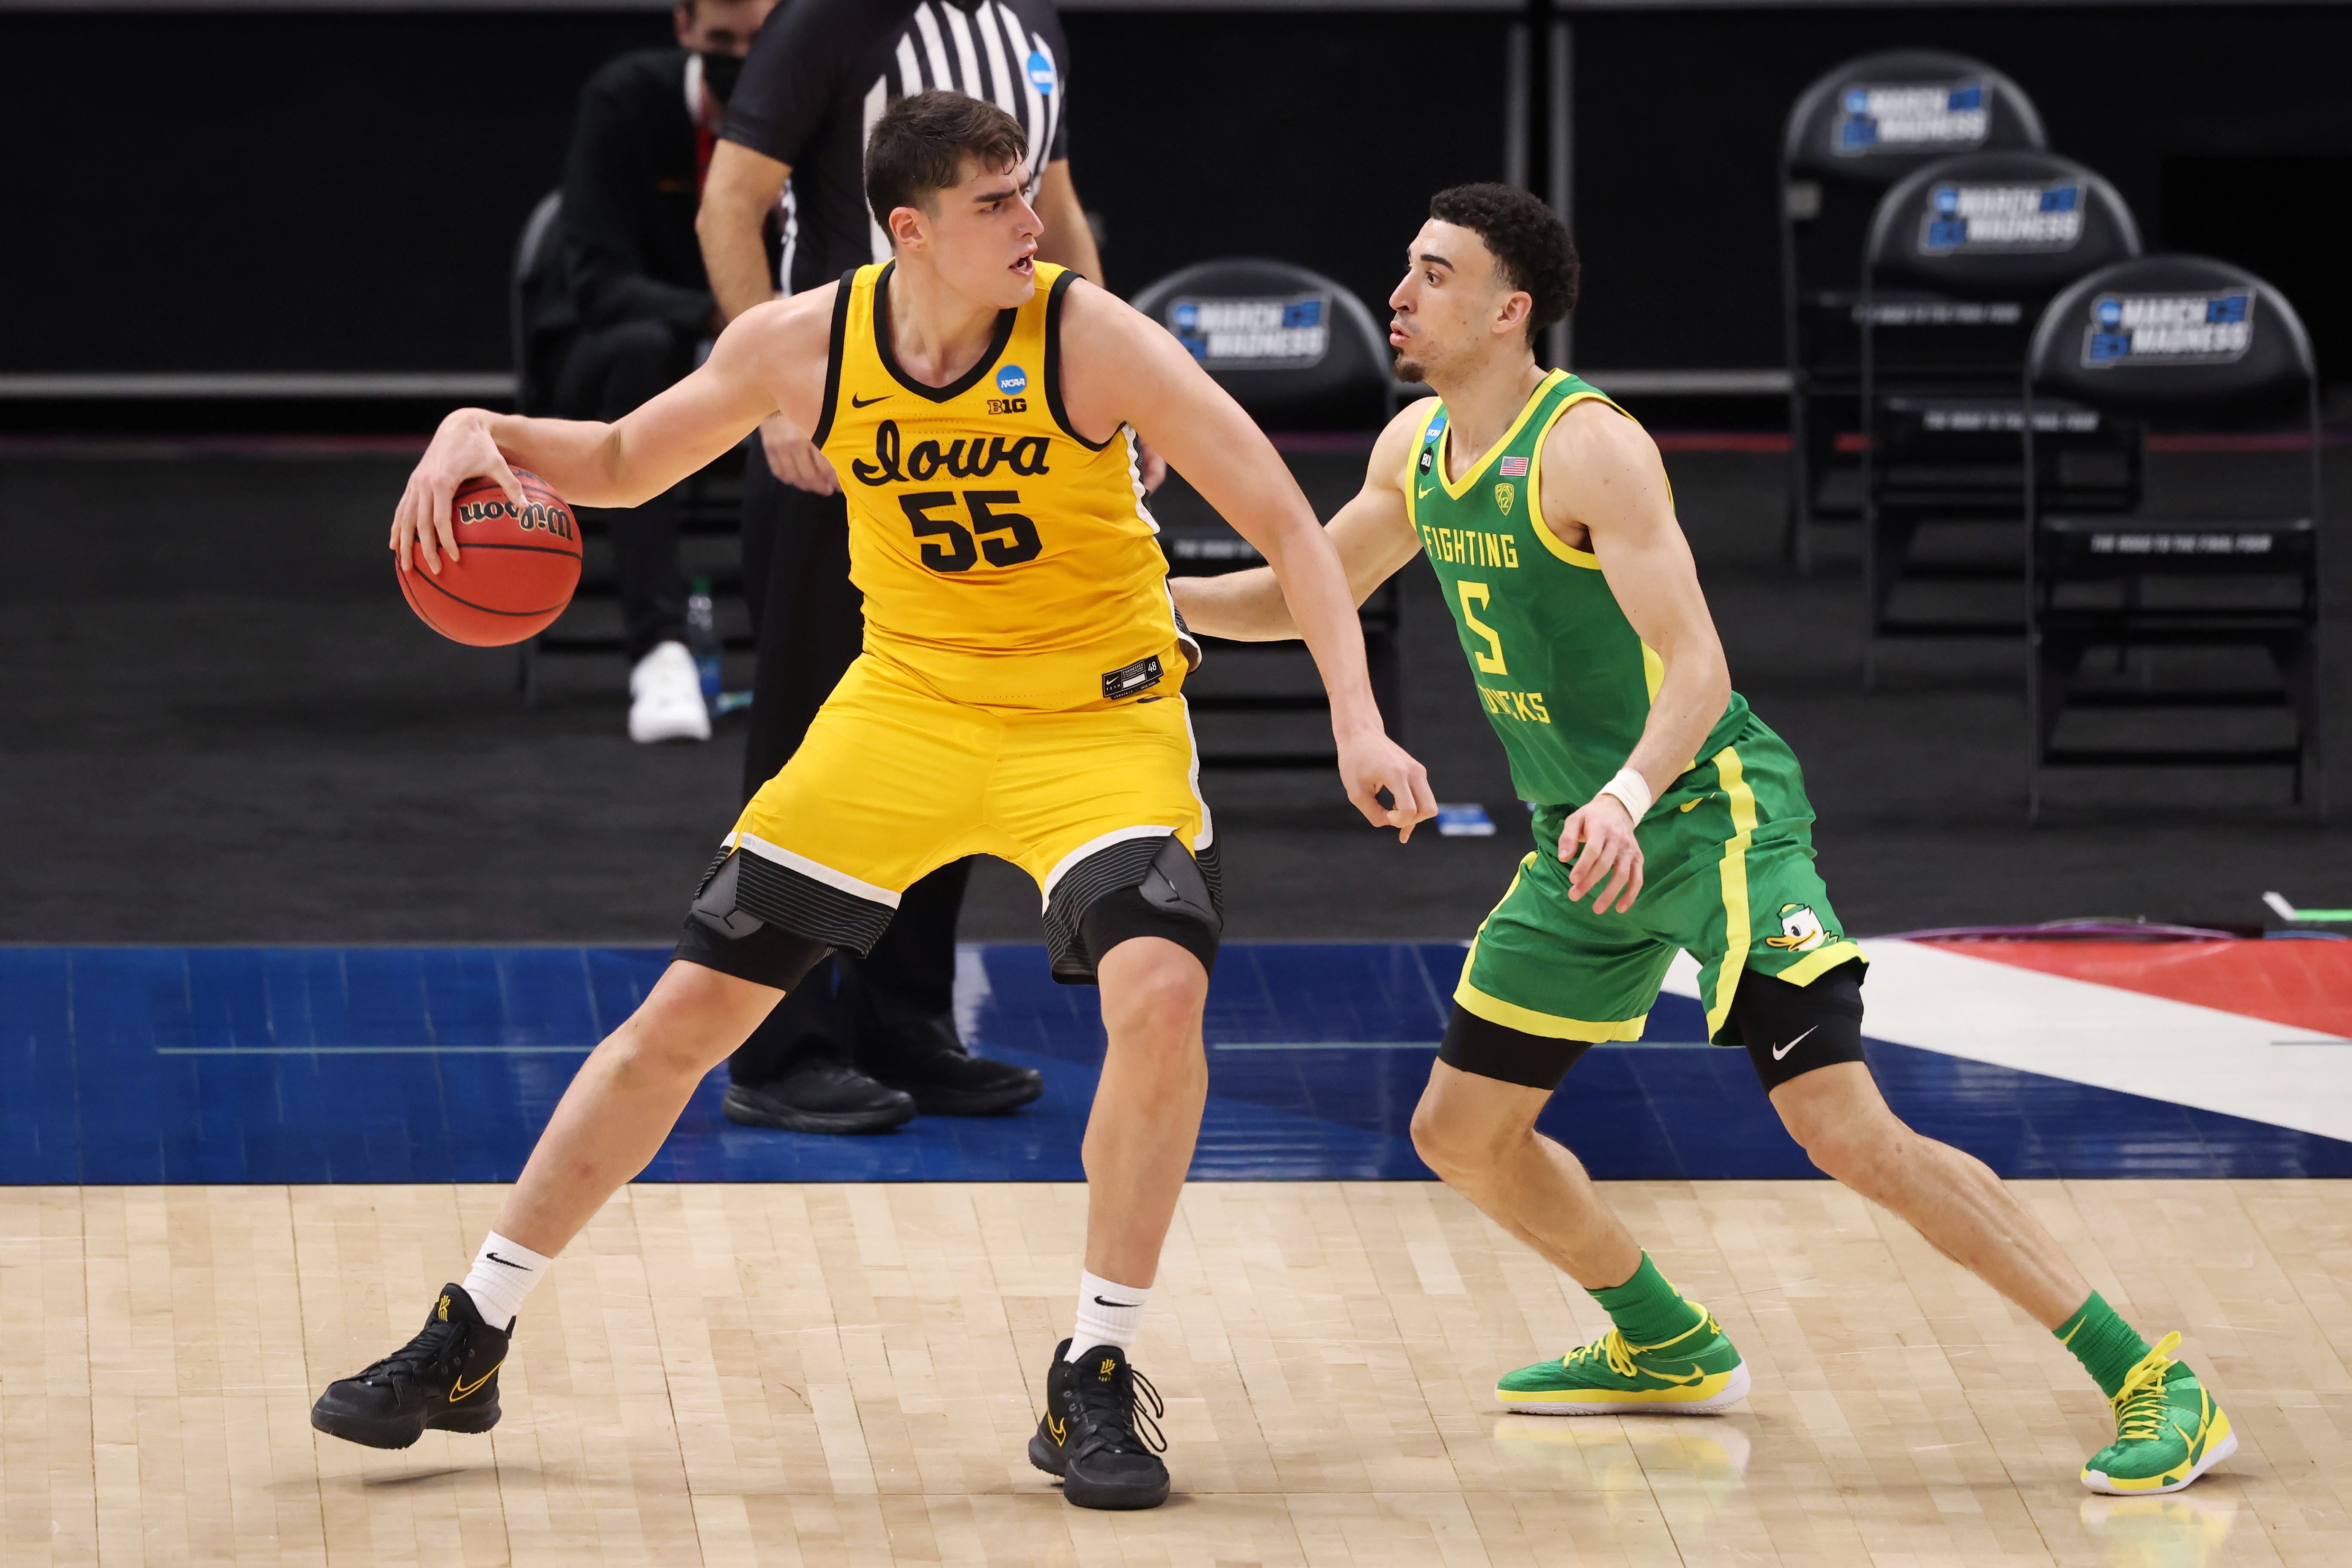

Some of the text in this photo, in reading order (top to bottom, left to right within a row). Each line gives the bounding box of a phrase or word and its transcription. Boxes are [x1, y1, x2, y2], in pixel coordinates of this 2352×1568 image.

[1001, 378, 1026, 389] NCAA
[1426, 429, 1441, 437] NCAA
[852, 420, 1050, 486] Iowa
[1501, 497, 1509, 508] 12
[898, 490, 1043, 573] 55
[1421, 524, 1519, 568] FIGHTING
[1457, 580, 1508, 675] 5
[1148, 661, 1157, 673] 48
